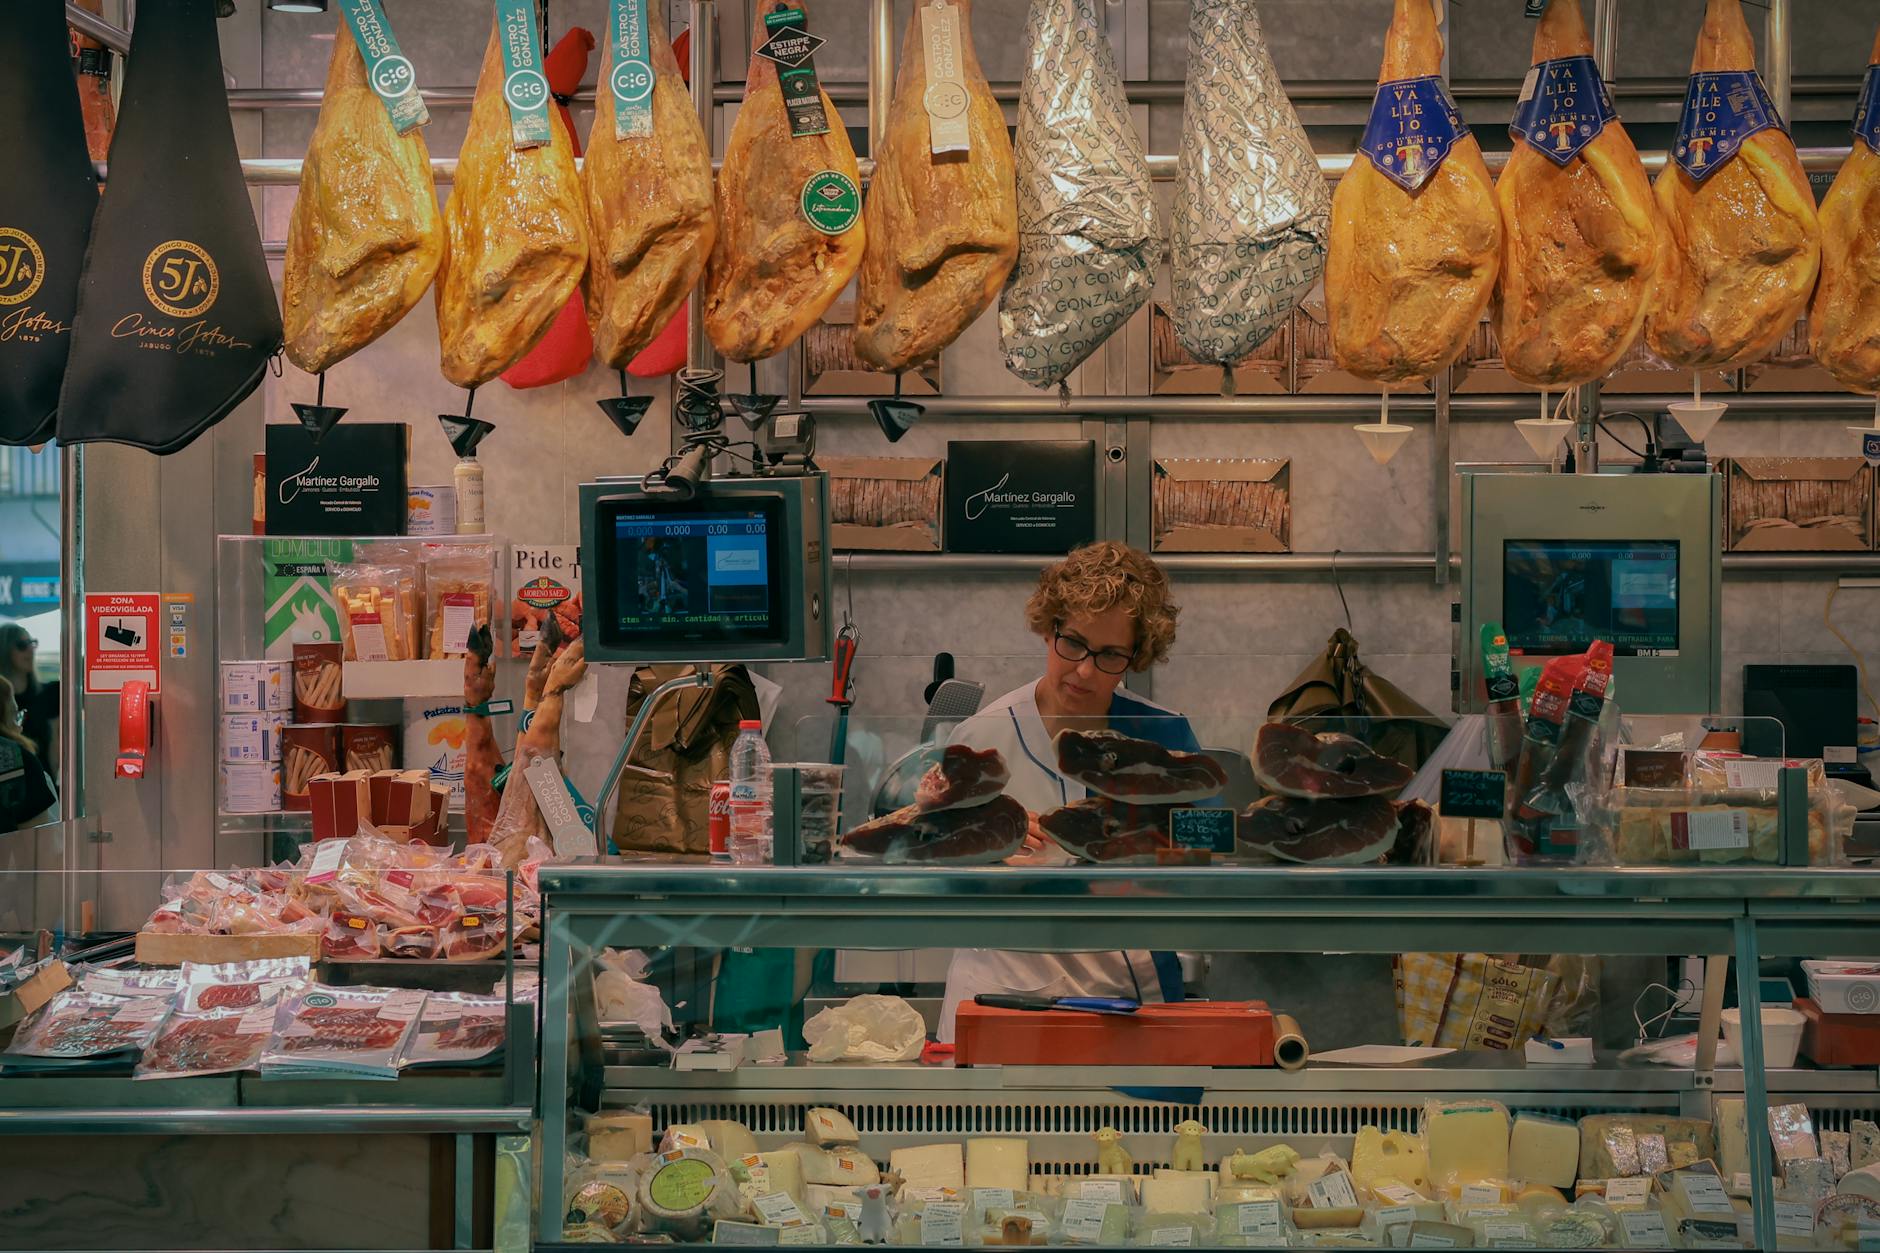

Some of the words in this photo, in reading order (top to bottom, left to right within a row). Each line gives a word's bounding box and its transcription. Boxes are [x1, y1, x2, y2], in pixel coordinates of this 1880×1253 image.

[351, 7, 361, 16] Y
[618, 4, 627, 12] Y
[620, 13, 630, 57] CASTRO
[931, 24, 941, 32] Y
[357, 16, 381, 58] CASTRO
[770, 36, 811, 50] ESTIRPE
[507, 24, 522, 68] CASTRO
[774, 45, 810, 57] NEGRA
[931, 35, 944, 78] CASTRO
[1531, 115, 1597, 128] GOURMET
[1195, 119, 1246, 161] CASTRO
[1377, 136, 1443, 150] GOURMET
[1207, 155, 1259, 196] CASTRO
[812, 203, 851, 213] Extremadura
[1185, 192, 1232, 232] CASTRO
[157, 241, 182, 253] CINCO
[184, 242, 207, 258] JOTAS
[158, 256, 202, 302] 5J
[152, 298, 189, 316] BELLOTA
[0, 306, 73, 342] Jotas
[111, 313, 177, 338] Cinco
[177, 320, 253, 354] Jotas
[138, 341, 172, 351] JABUGO
[296, 475, 338, 487] Martínez
[339, 475, 380, 489] Gargallo
[984, 491, 1030, 503] Martínez
[1031, 491, 1076, 505] Gargallo
[271, 539, 341, 557] DOMICILIO
[516, 550, 563, 569] Pide
[296, 564, 319, 574] ESPAÑA
[320, 564, 327, 574] Y
[523, 590, 549, 598] MORENO
[685, 615, 721, 623] cantidad
[424, 706, 461, 721] Patatas
[537, 780, 545, 789] Y
[541, 789, 563, 827] CASTRO
[1490, 976, 1519, 988] SÓLO
